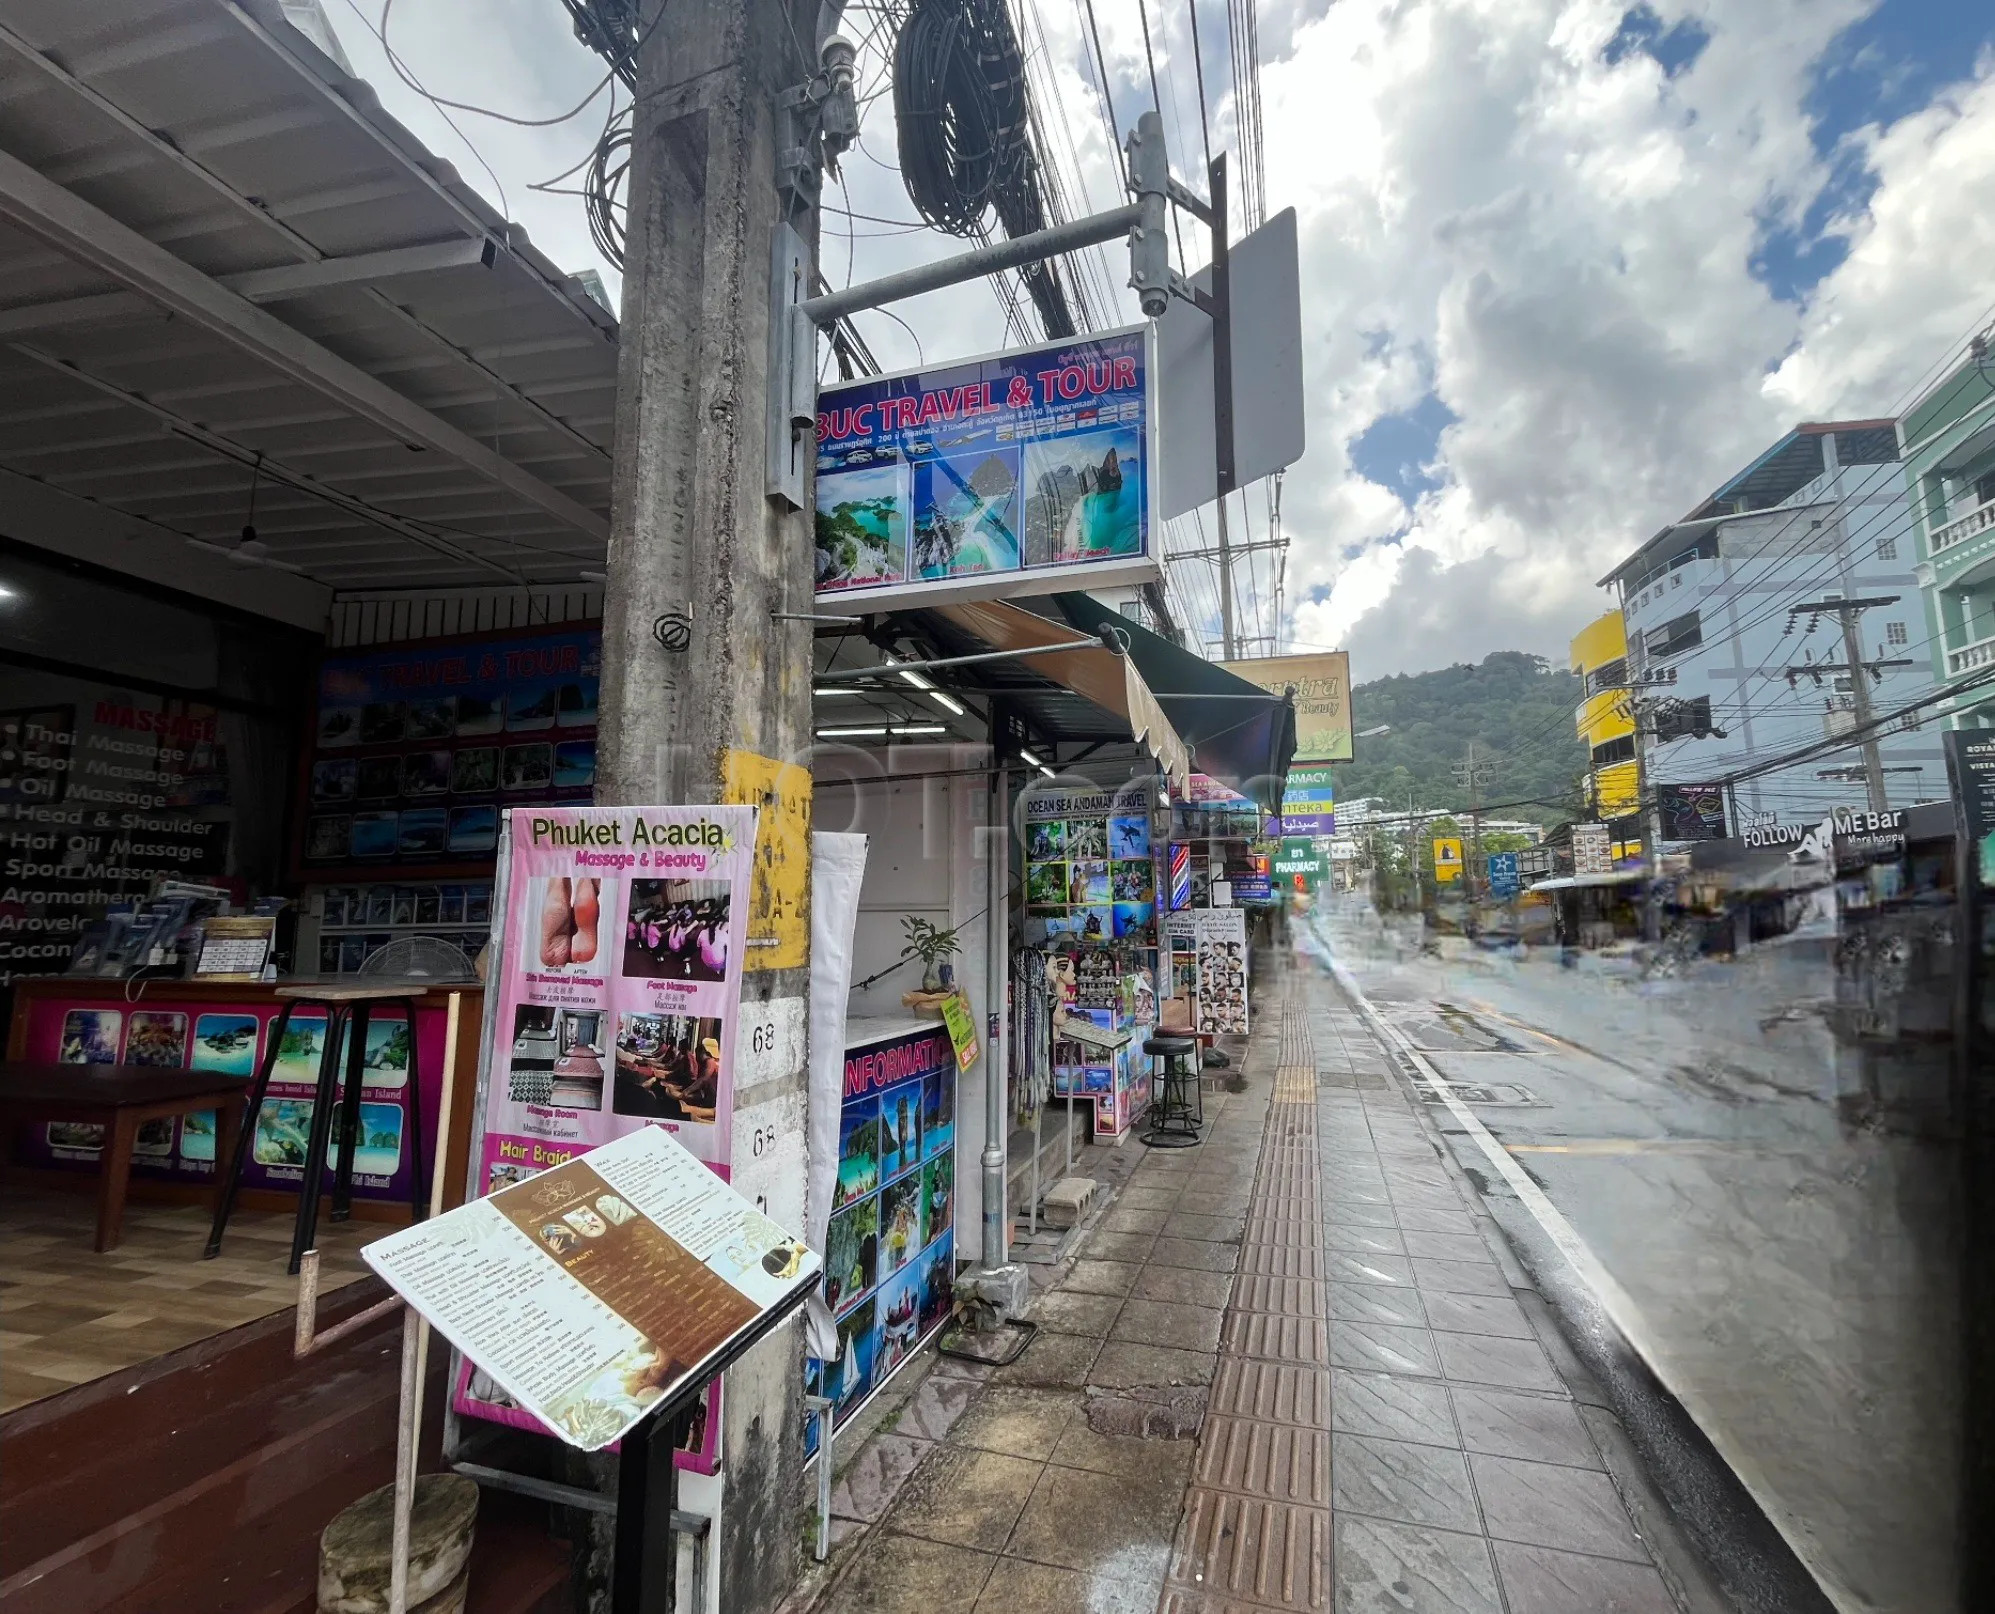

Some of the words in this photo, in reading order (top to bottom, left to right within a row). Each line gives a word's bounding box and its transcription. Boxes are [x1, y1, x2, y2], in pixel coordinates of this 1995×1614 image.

[877, 381, 999, 432] TRAVEL
[1006, 375, 1033, 409] &
[1037, 356, 1138, 404] TOUR
[878, 434, 892, 443] 200
[505, 644, 580, 679] TOUR
[1301, 701, 1339, 718] Beauty
[26, 724, 78, 747] Thai
[88, 734, 186, 763] Massage
[22, 751, 75, 772] Foot
[86, 759, 184, 787] Massage
[20, 778, 56, 797] Oil
[66, 784, 166, 810] Massage
[1028, 801, 1054, 813] OCEAN
[1056, 799, 1072, 811] SEA
[1073, 796, 1114, 811] ANDAMAN
[1117, 794, 1147, 807] TRAVEL
[14, 803, 83, 826] Head
[93, 811, 112, 828] &
[120, 813, 213, 836] Shoulder
[532, 818, 622, 845] Phuket
[632, 816, 723, 846] Acacia
[1743, 824, 1803, 849] FOLLOW
[1835, 814, 1863, 835] ME
[1865, 811, 1902, 830] Bar
[1873, 832, 1905, 845] happy
[10, 832, 58, 852] Hot
[67, 835, 101, 854] Oil
[110, 839, 204, 863] Massage
[5, 858, 74, 879] Sport
[575, 851, 634, 871] Massage
[639, 852, 650, 867] &
[655, 851, 706, 872] Beauty
[1275, 861, 1320, 873] PHARMACY
[647, 980, 666, 990] Foot
[667, 982, 698, 995] Massage
[753, 1023, 775, 1054] 68
[375, 1089, 402, 1100] Island
[555, 1107, 578, 1119] Room
[553, 1127, 579, 1138] кабинет
[754, 1124, 776, 1157] 68
[499, 1140, 529, 1160] Hair
[534, 1144, 573, 1165] Braid
[593, 1157, 611, 1167] WAX
[364, 1175, 391, 1189] Island
[379, 1236, 431, 1261] MASSAGE
[402, 1249, 428, 1263] Massage
[563, 1247, 595, 1267] BEAUTY
[413, 1259, 439, 1274] Massage
[420, 1272, 447, 1286] Massage
[457, 1271, 482, 1285] Massage
[479, 1277, 503, 1291] Massage
[494, 1286, 516, 1300] Massage
[485, 1342, 509, 1358] Coconut
[511, 1364, 537, 1382] Massage
[555, 1356, 578, 1373] Massage
